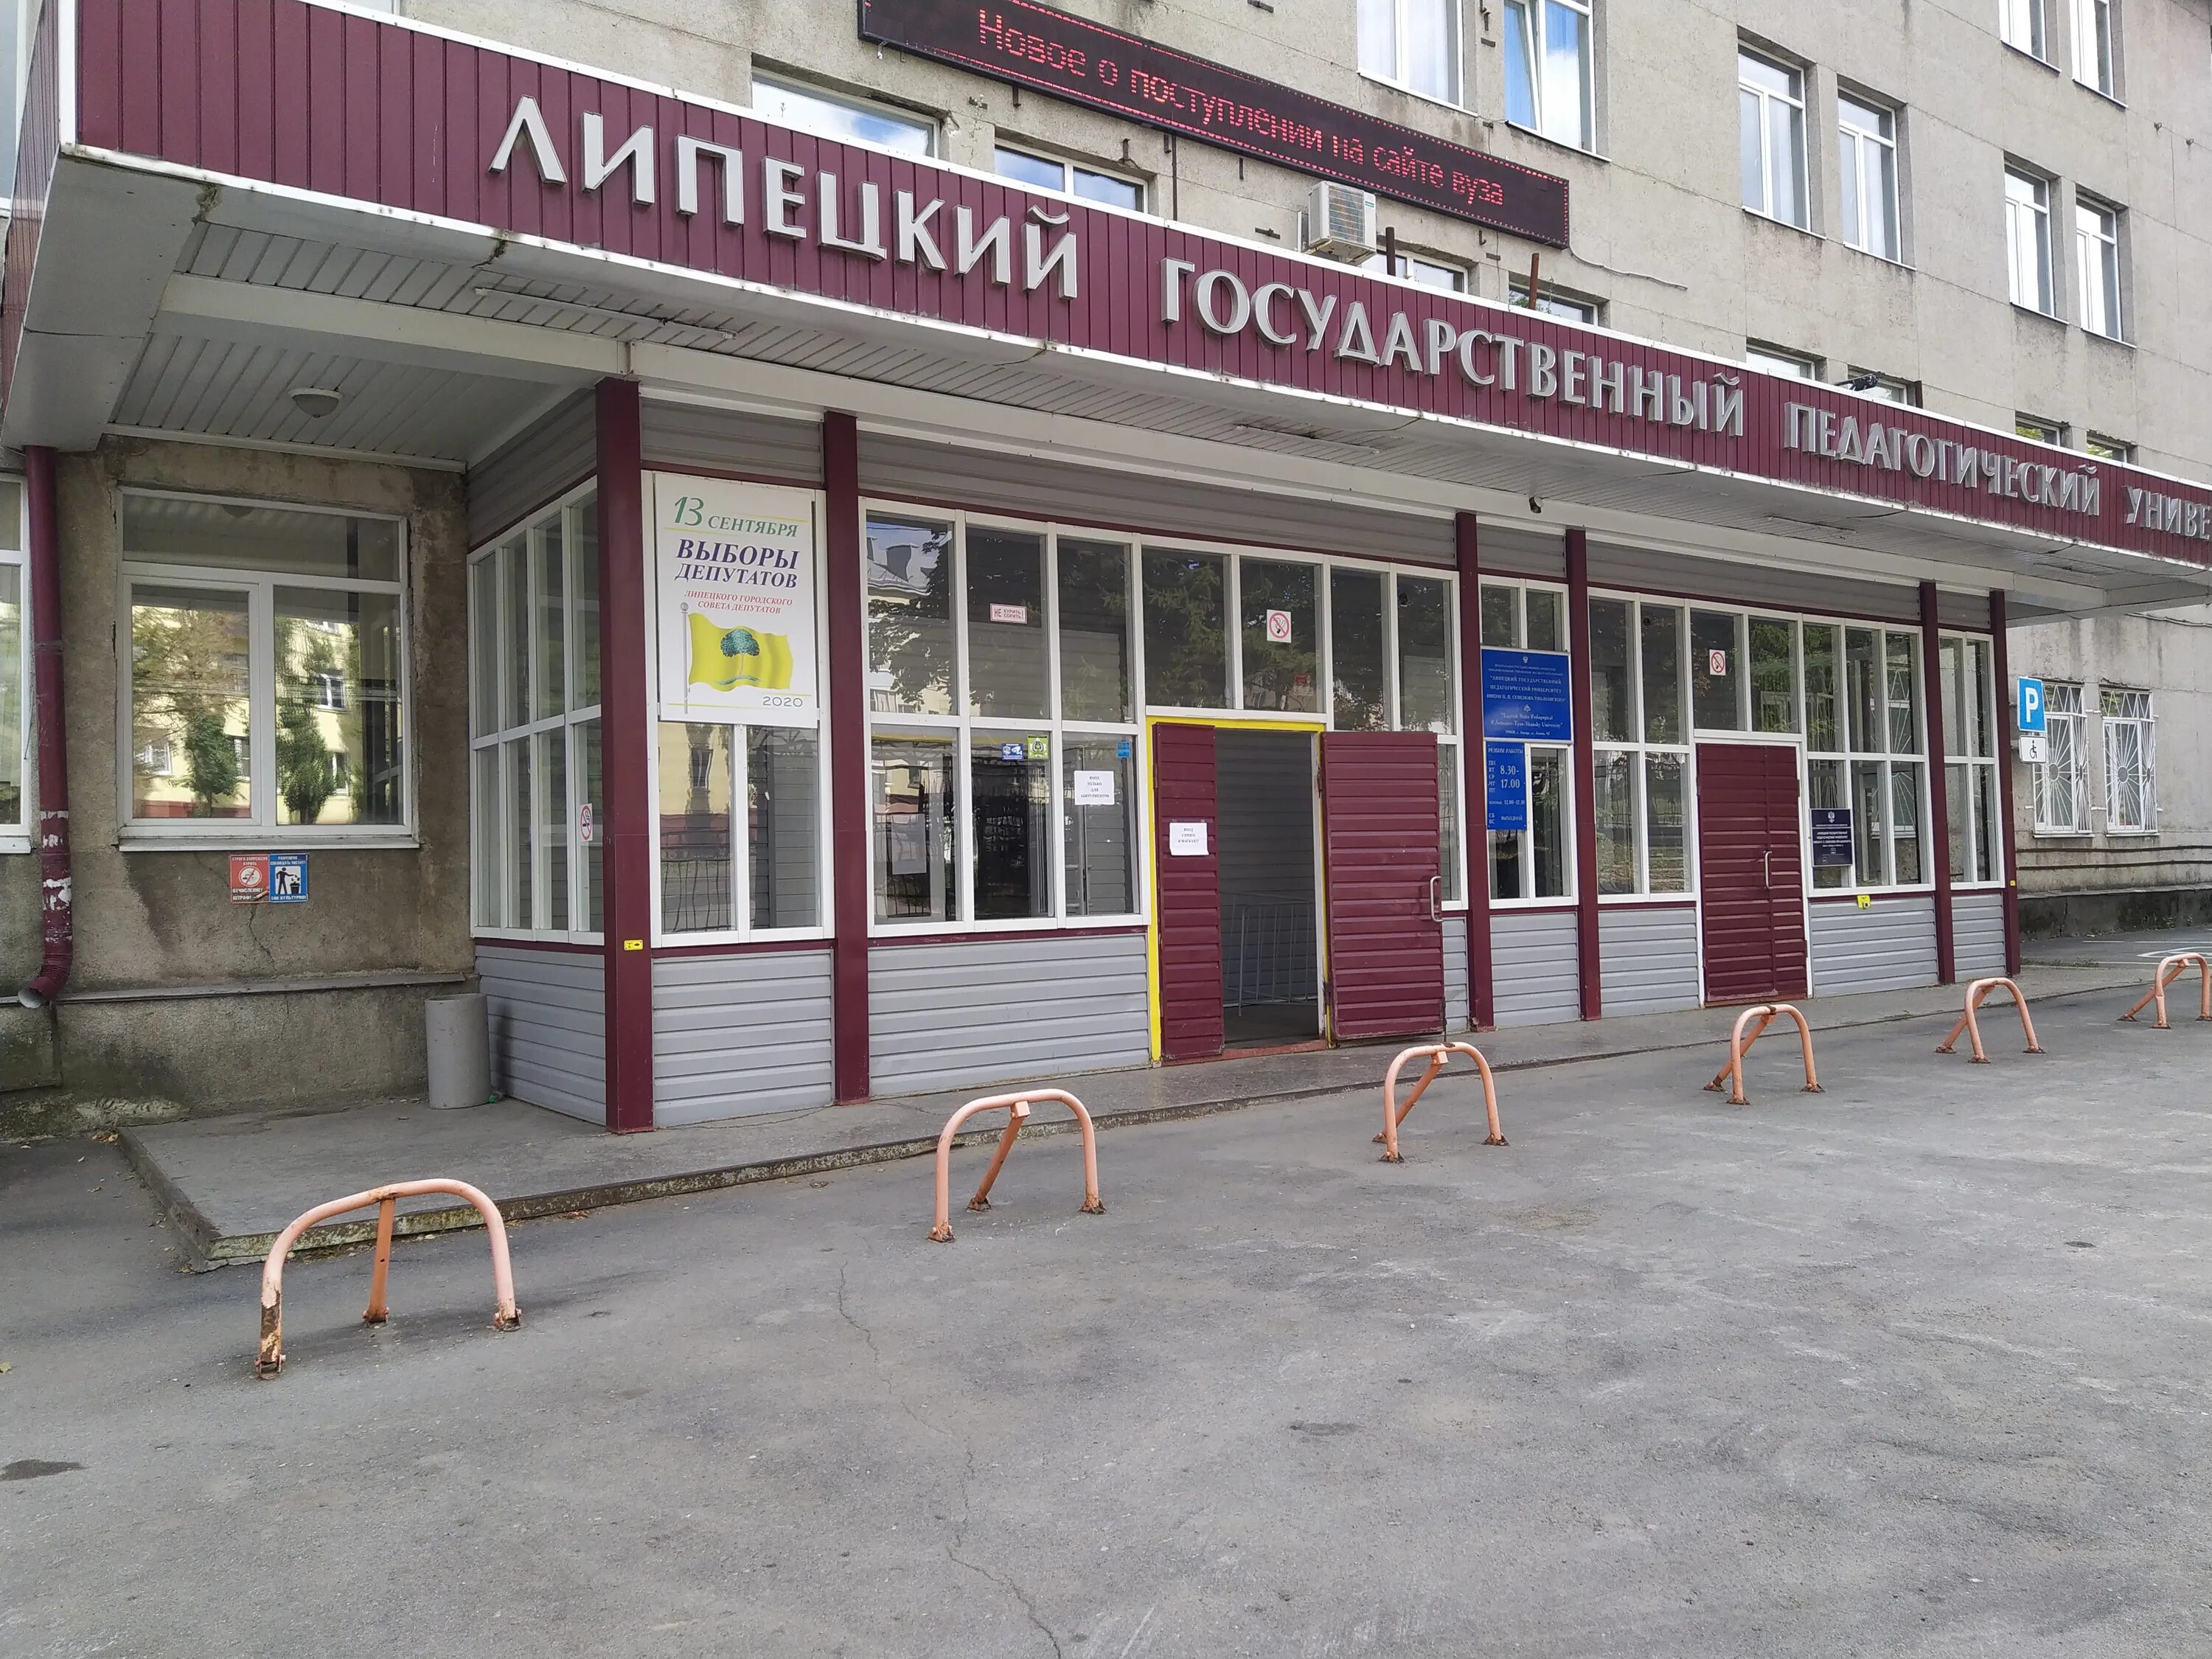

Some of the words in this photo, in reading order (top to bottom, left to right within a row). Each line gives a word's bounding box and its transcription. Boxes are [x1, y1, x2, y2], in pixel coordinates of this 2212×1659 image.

[980, 9, 1086, 77] Новое
[1098, 59, 1118, 86] о
[1131, 69, 1323, 153] поступлении
[1332, 135, 1364, 165] на
[1373, 146, 1444, 189] сайте
[1452, 170, 1504, 206] вуза
[488, 94, 1078, 301] ЛИПЕЦКИЙ
[1161, 257, 1744, 438] ГОСУДАРСТВЕННЫЙ
[1783, 400, 2100, 517] ПЕДАГОГИЧЕСКИЙ
[674, 495, 704, 527] 13
[708, 515, 799, 538] СЕНТЯБРЯ
[675, 538, 800, 570] ВЫБОРЫ
[675, 563, 798, 588] ДЕПУТАТОВ
[684, 590, 737, 601] ЛИПЕЦКОГО
[739, 595, 793, 606] ГОРОДСКОГО
[698, 600, 730, 610] СОВЕТА
[731, 603, 781, 614] ДЕПУТАТОВ
[994, 608, 1001, 617] НЕ
[762, 696, 803, 707] 2020
[2025, 686, 2039, 723] P
[1501, 779, 1520, 789] 17.00
